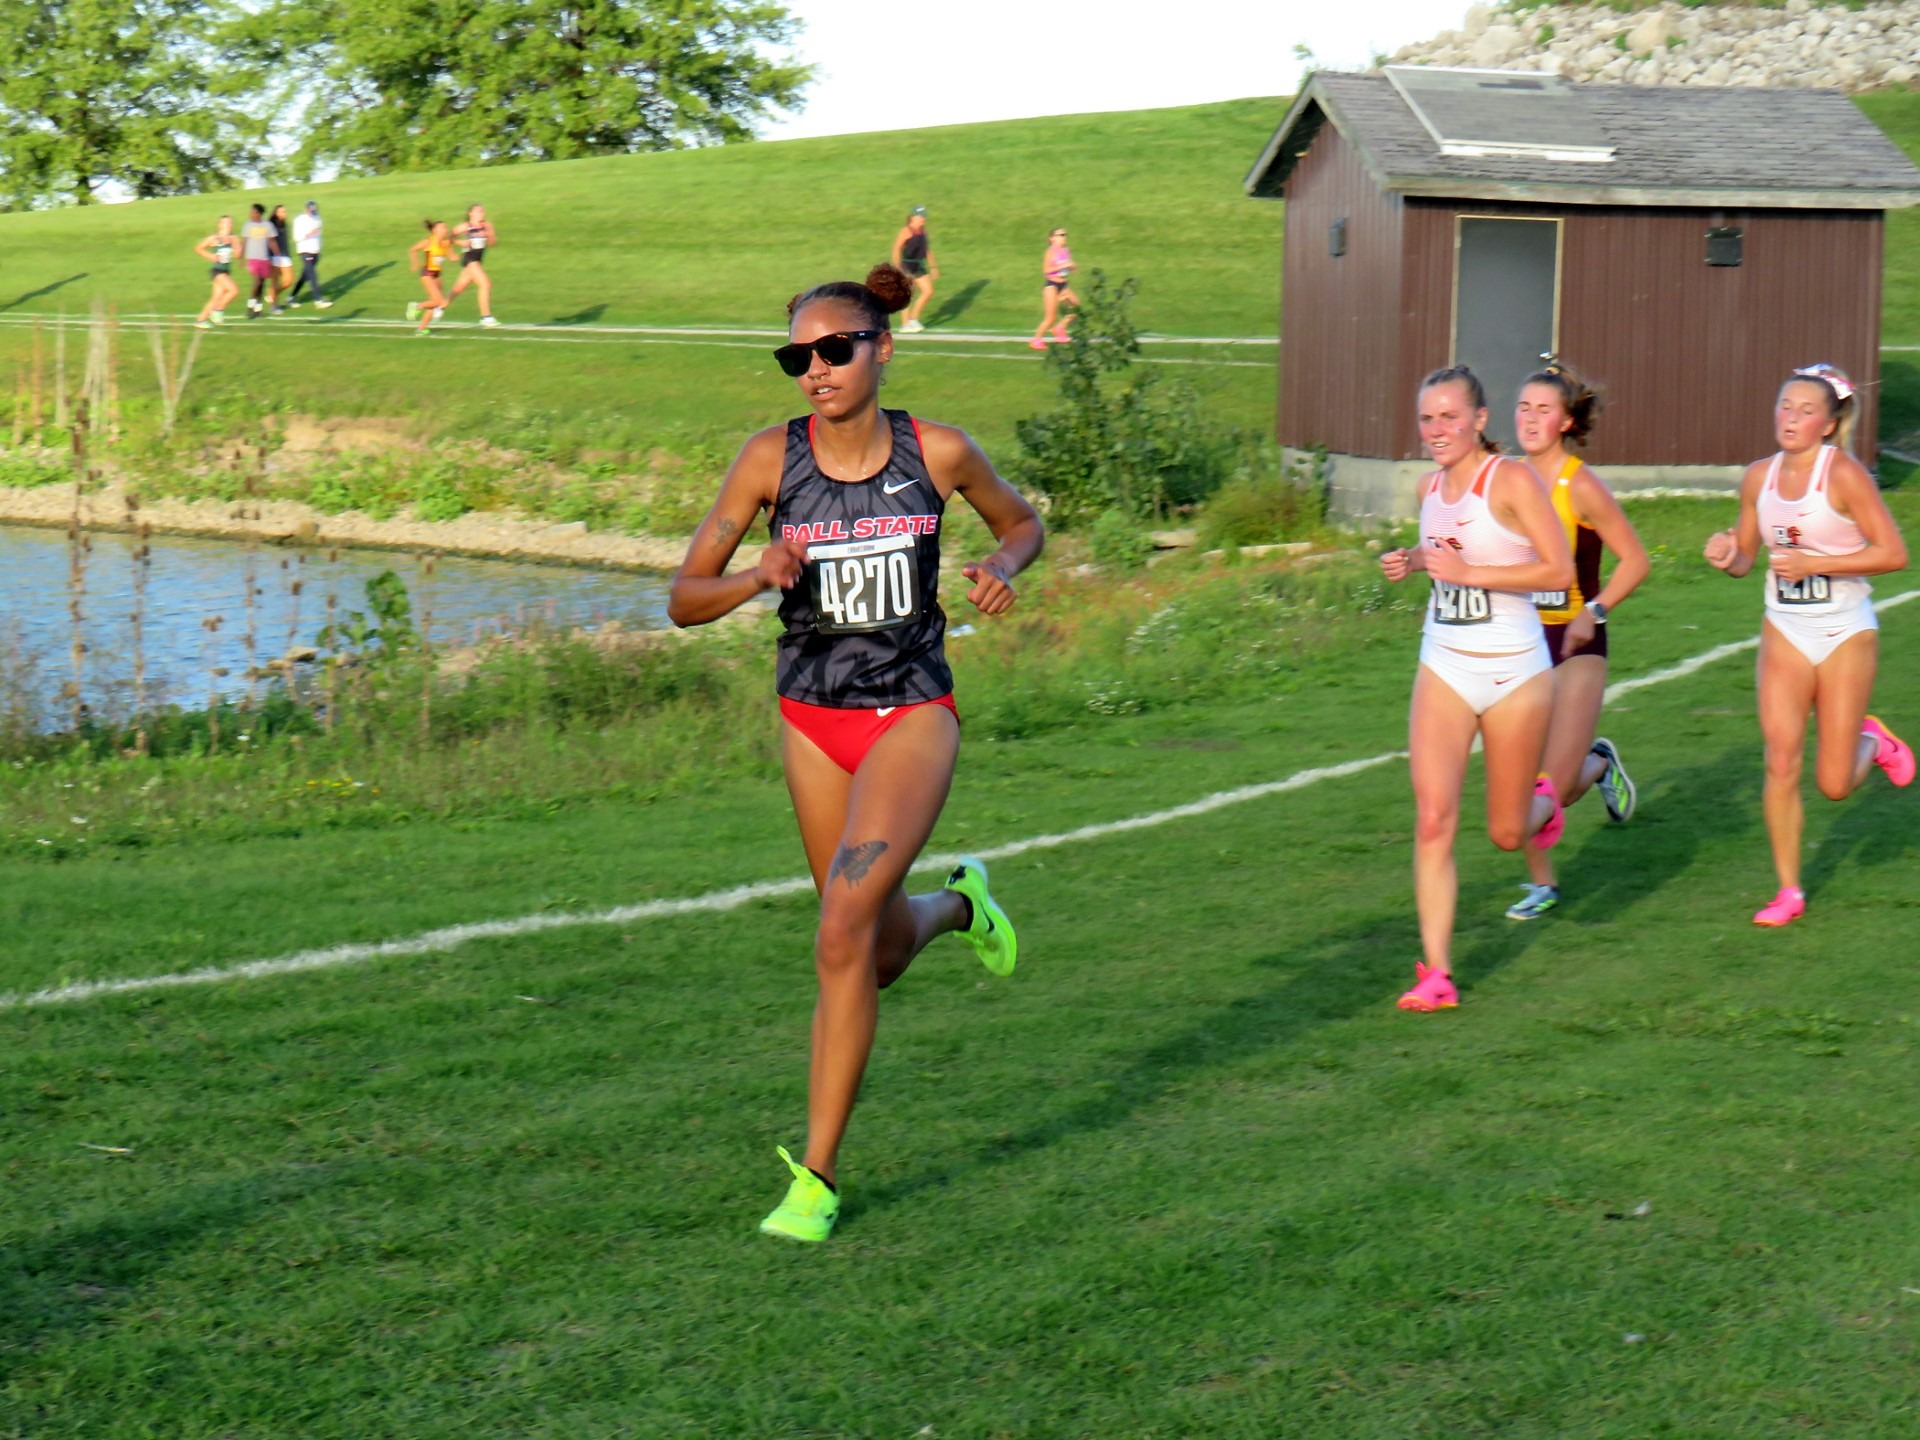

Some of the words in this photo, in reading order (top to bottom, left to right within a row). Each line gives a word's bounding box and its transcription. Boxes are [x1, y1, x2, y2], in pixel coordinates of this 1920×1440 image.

[782, 521, 849, 542] BALL
[853, 514, 938, 538] STATE
[820, 552, 912, 624] 4270
